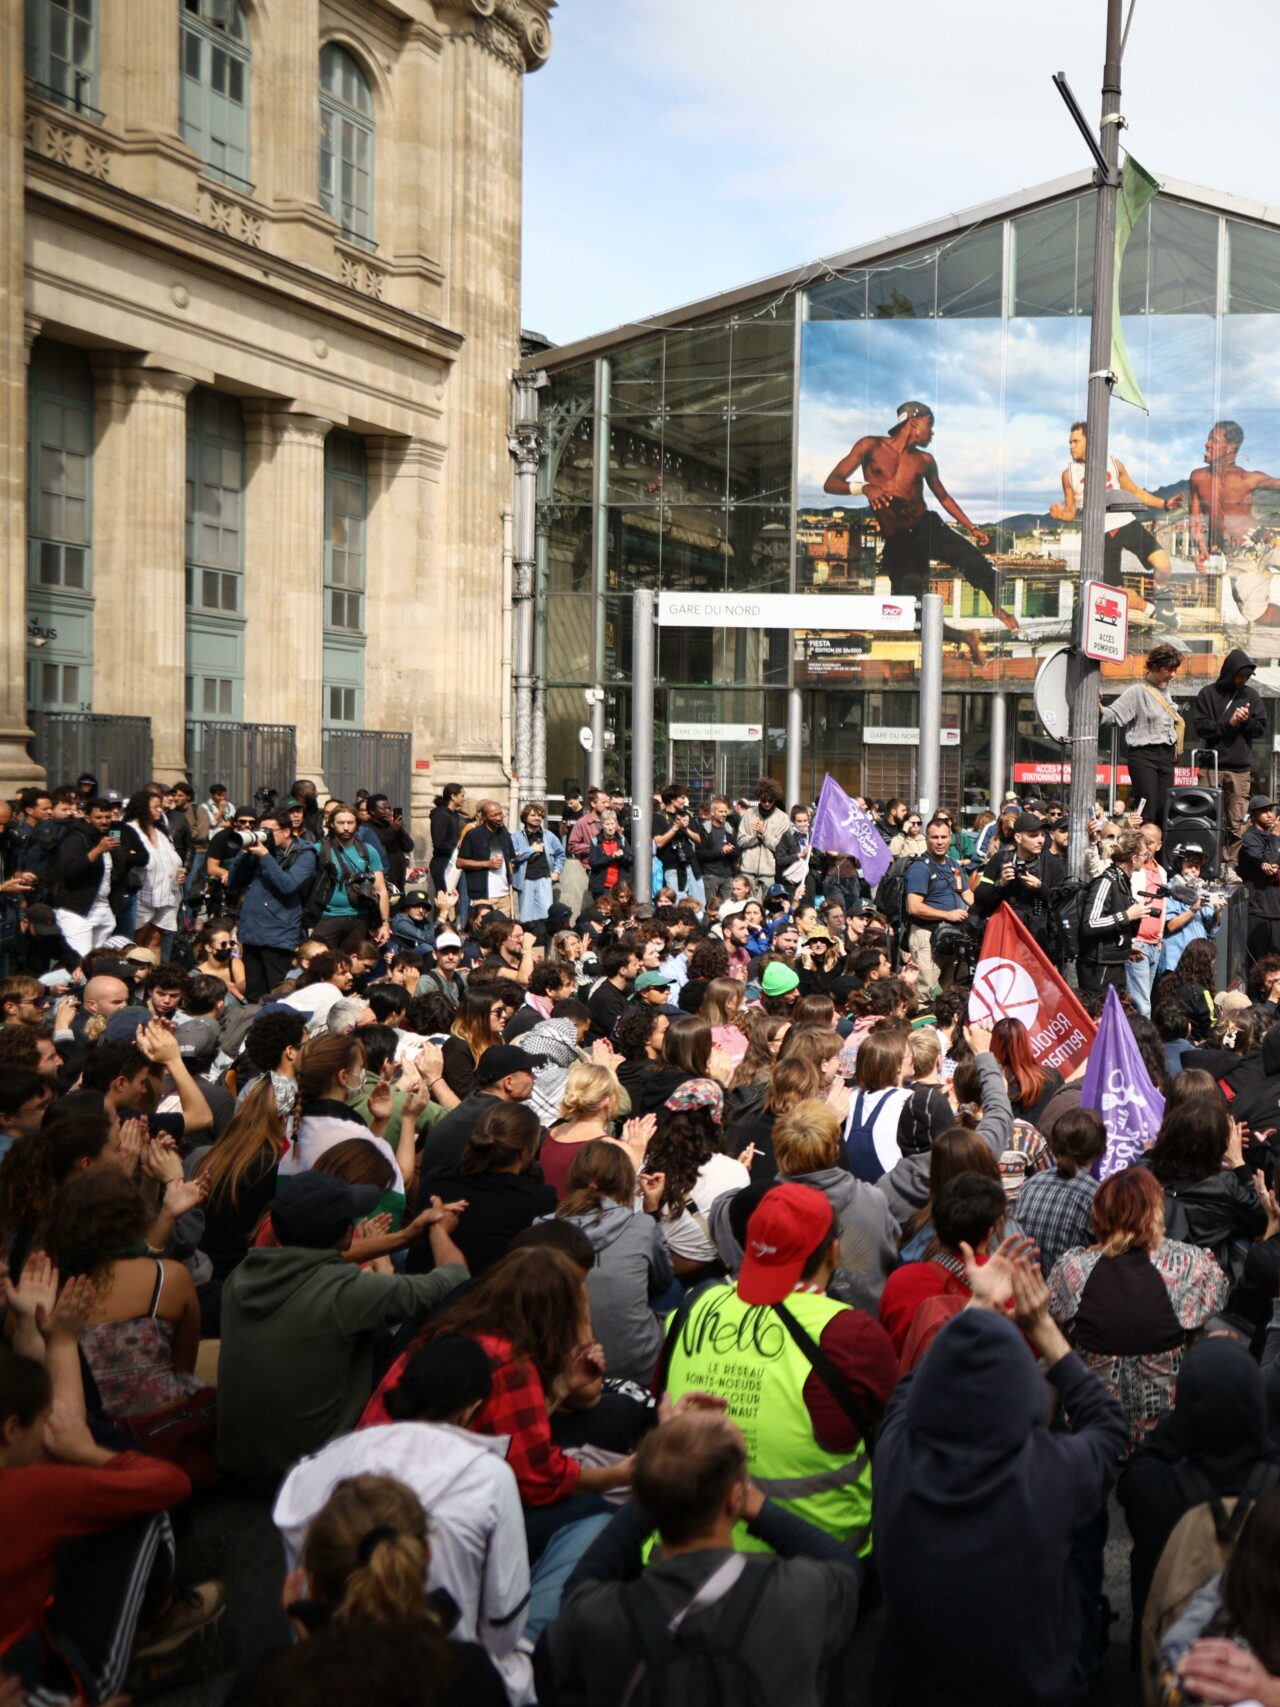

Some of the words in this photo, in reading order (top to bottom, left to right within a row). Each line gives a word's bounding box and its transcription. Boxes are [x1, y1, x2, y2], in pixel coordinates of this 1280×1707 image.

[669, 604, 700, 615] GARE
[704, 604, 722, 616] DU
[725, 605, 761, 617] NORD
[1094, 642, 1119, 656] POMPIERS
[704, 728, 725, 736] NORD
[890, 732, 900, 740] DU
[1036, 764, 1056, 773] ACCES
[1022, 773, 1071, 783] STATIONNEMEN
[708, 1362, 718, 1375] LE
[724, 1361, 765, 1378] RÉSEAU
